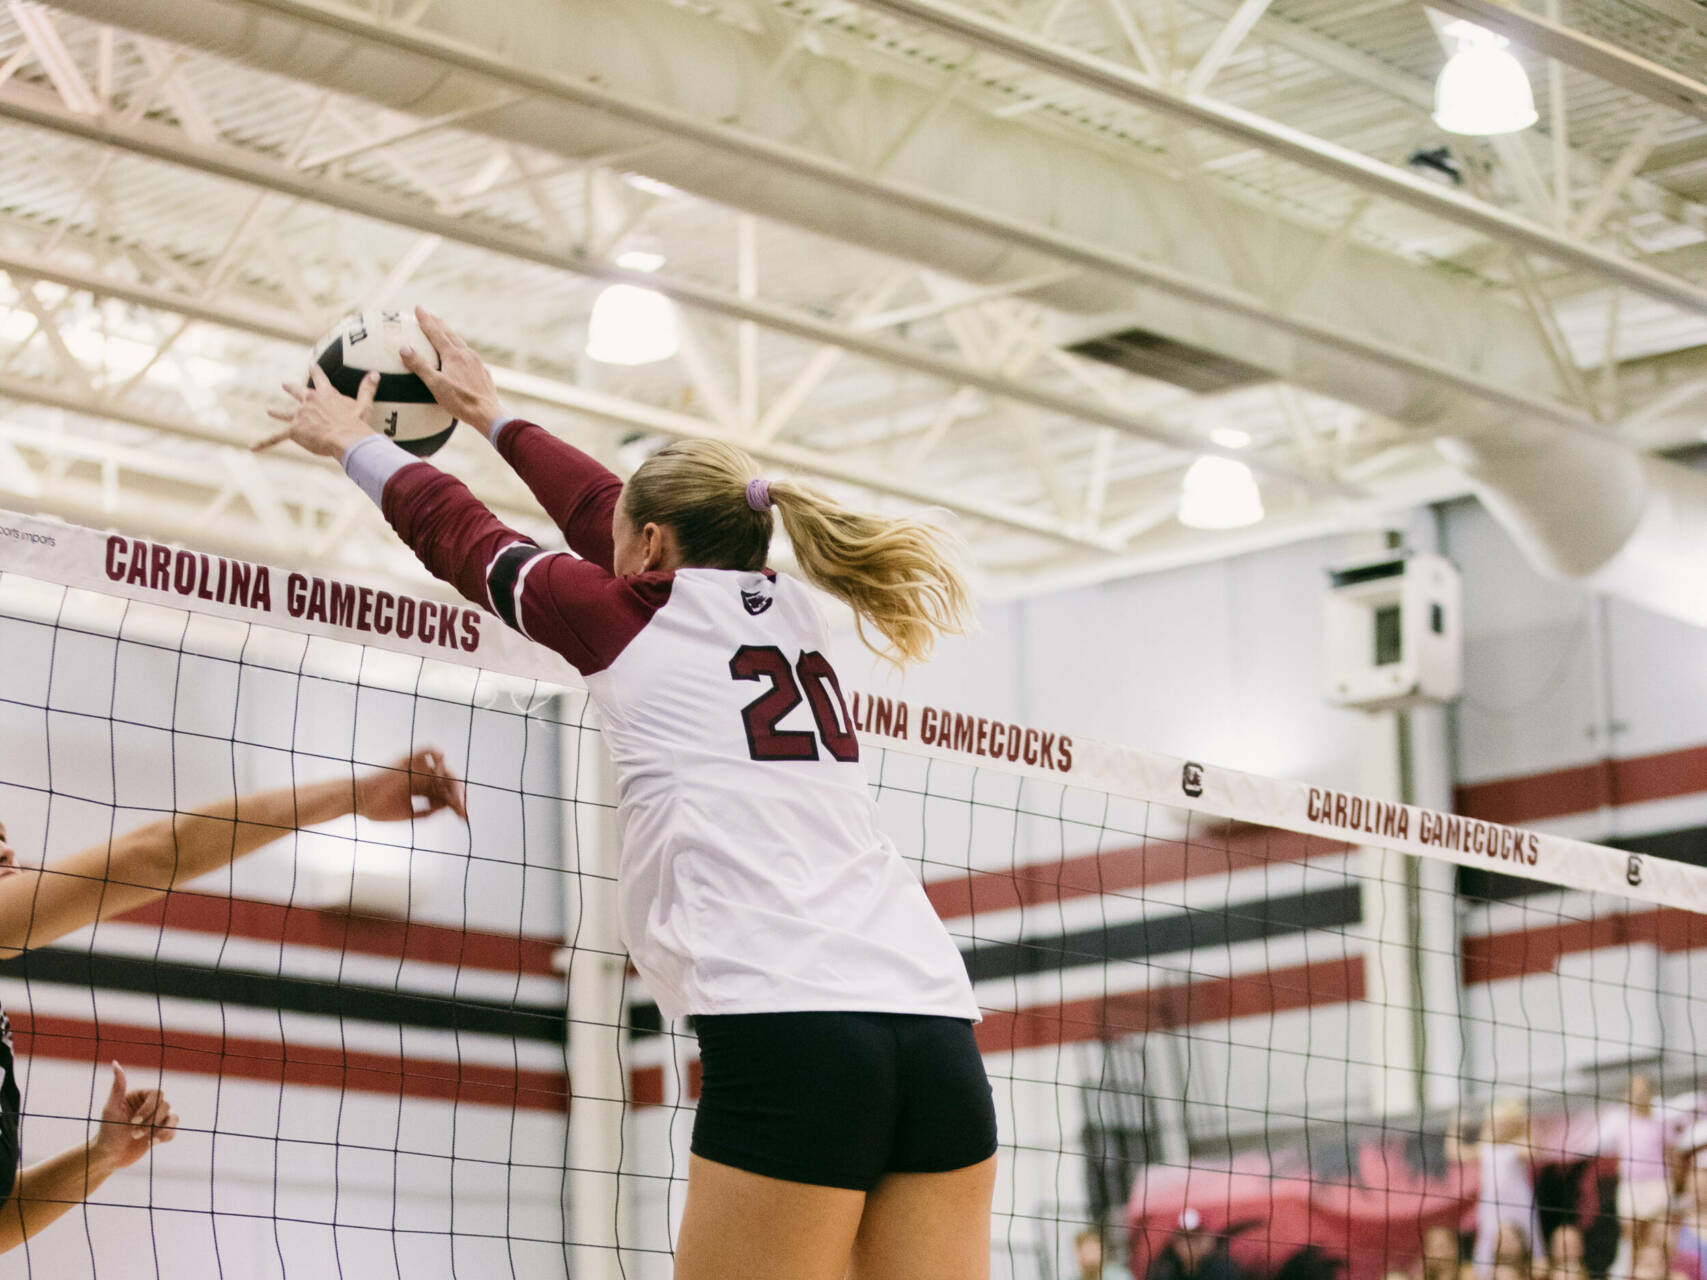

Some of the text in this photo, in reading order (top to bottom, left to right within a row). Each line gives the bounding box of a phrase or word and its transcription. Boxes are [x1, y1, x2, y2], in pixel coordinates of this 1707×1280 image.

[105, 534, 481, 653] CAROLINA GAMECOCKS
[728, 644, 860, 763] 20
[920, 706, 1074, 773] GAMECOCKS
[1306, 787, 1539, 867] CAROLINA GAMECOCKS
